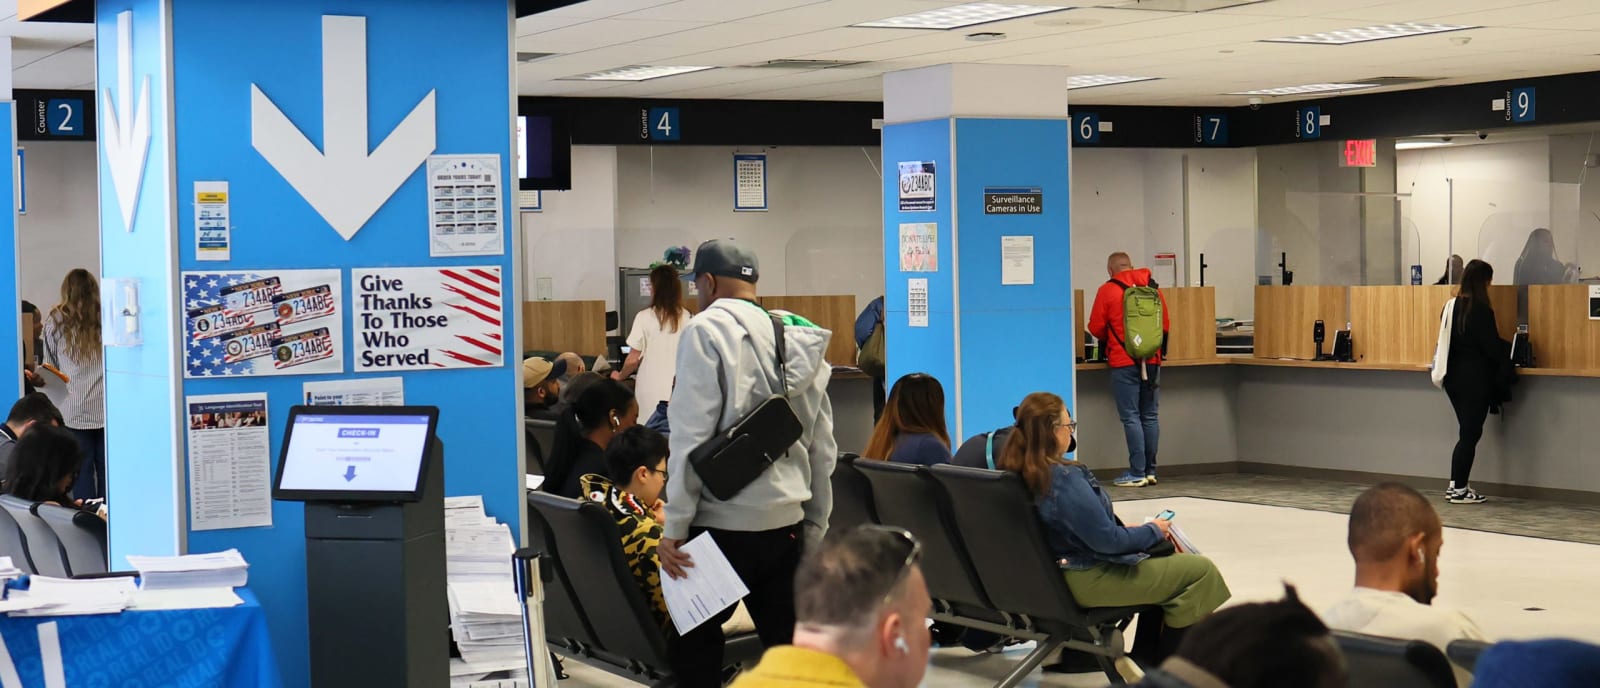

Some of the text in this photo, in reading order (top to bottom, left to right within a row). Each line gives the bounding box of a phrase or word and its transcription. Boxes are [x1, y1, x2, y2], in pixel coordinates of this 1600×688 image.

[1518, 91, 1529, 118] 9
[37, 100, 73, 134] Counter 2
[656, 111, 672, 137] 4
[1080, 116, 1092, 139] 6
[1306, 111, 1315, 134] 8
[1209, 118, 1220, 140] 7
[1346, 139, 1375, 166] EXIT
[986, 204, 1041, 213] Cameras in Use
[991, 195, 1035, 204] Surveillance
[360, 274, 403, 292] Give
[293, 294, 330, 316] 234ABC
[360, 293, 433, 311] Thanks
[361, 311, 448, 330] To Those
[292, 337, 329, 359] 234ABC
[362, 331, 410, 348] Who
[362, 349, 429, 368] Served
